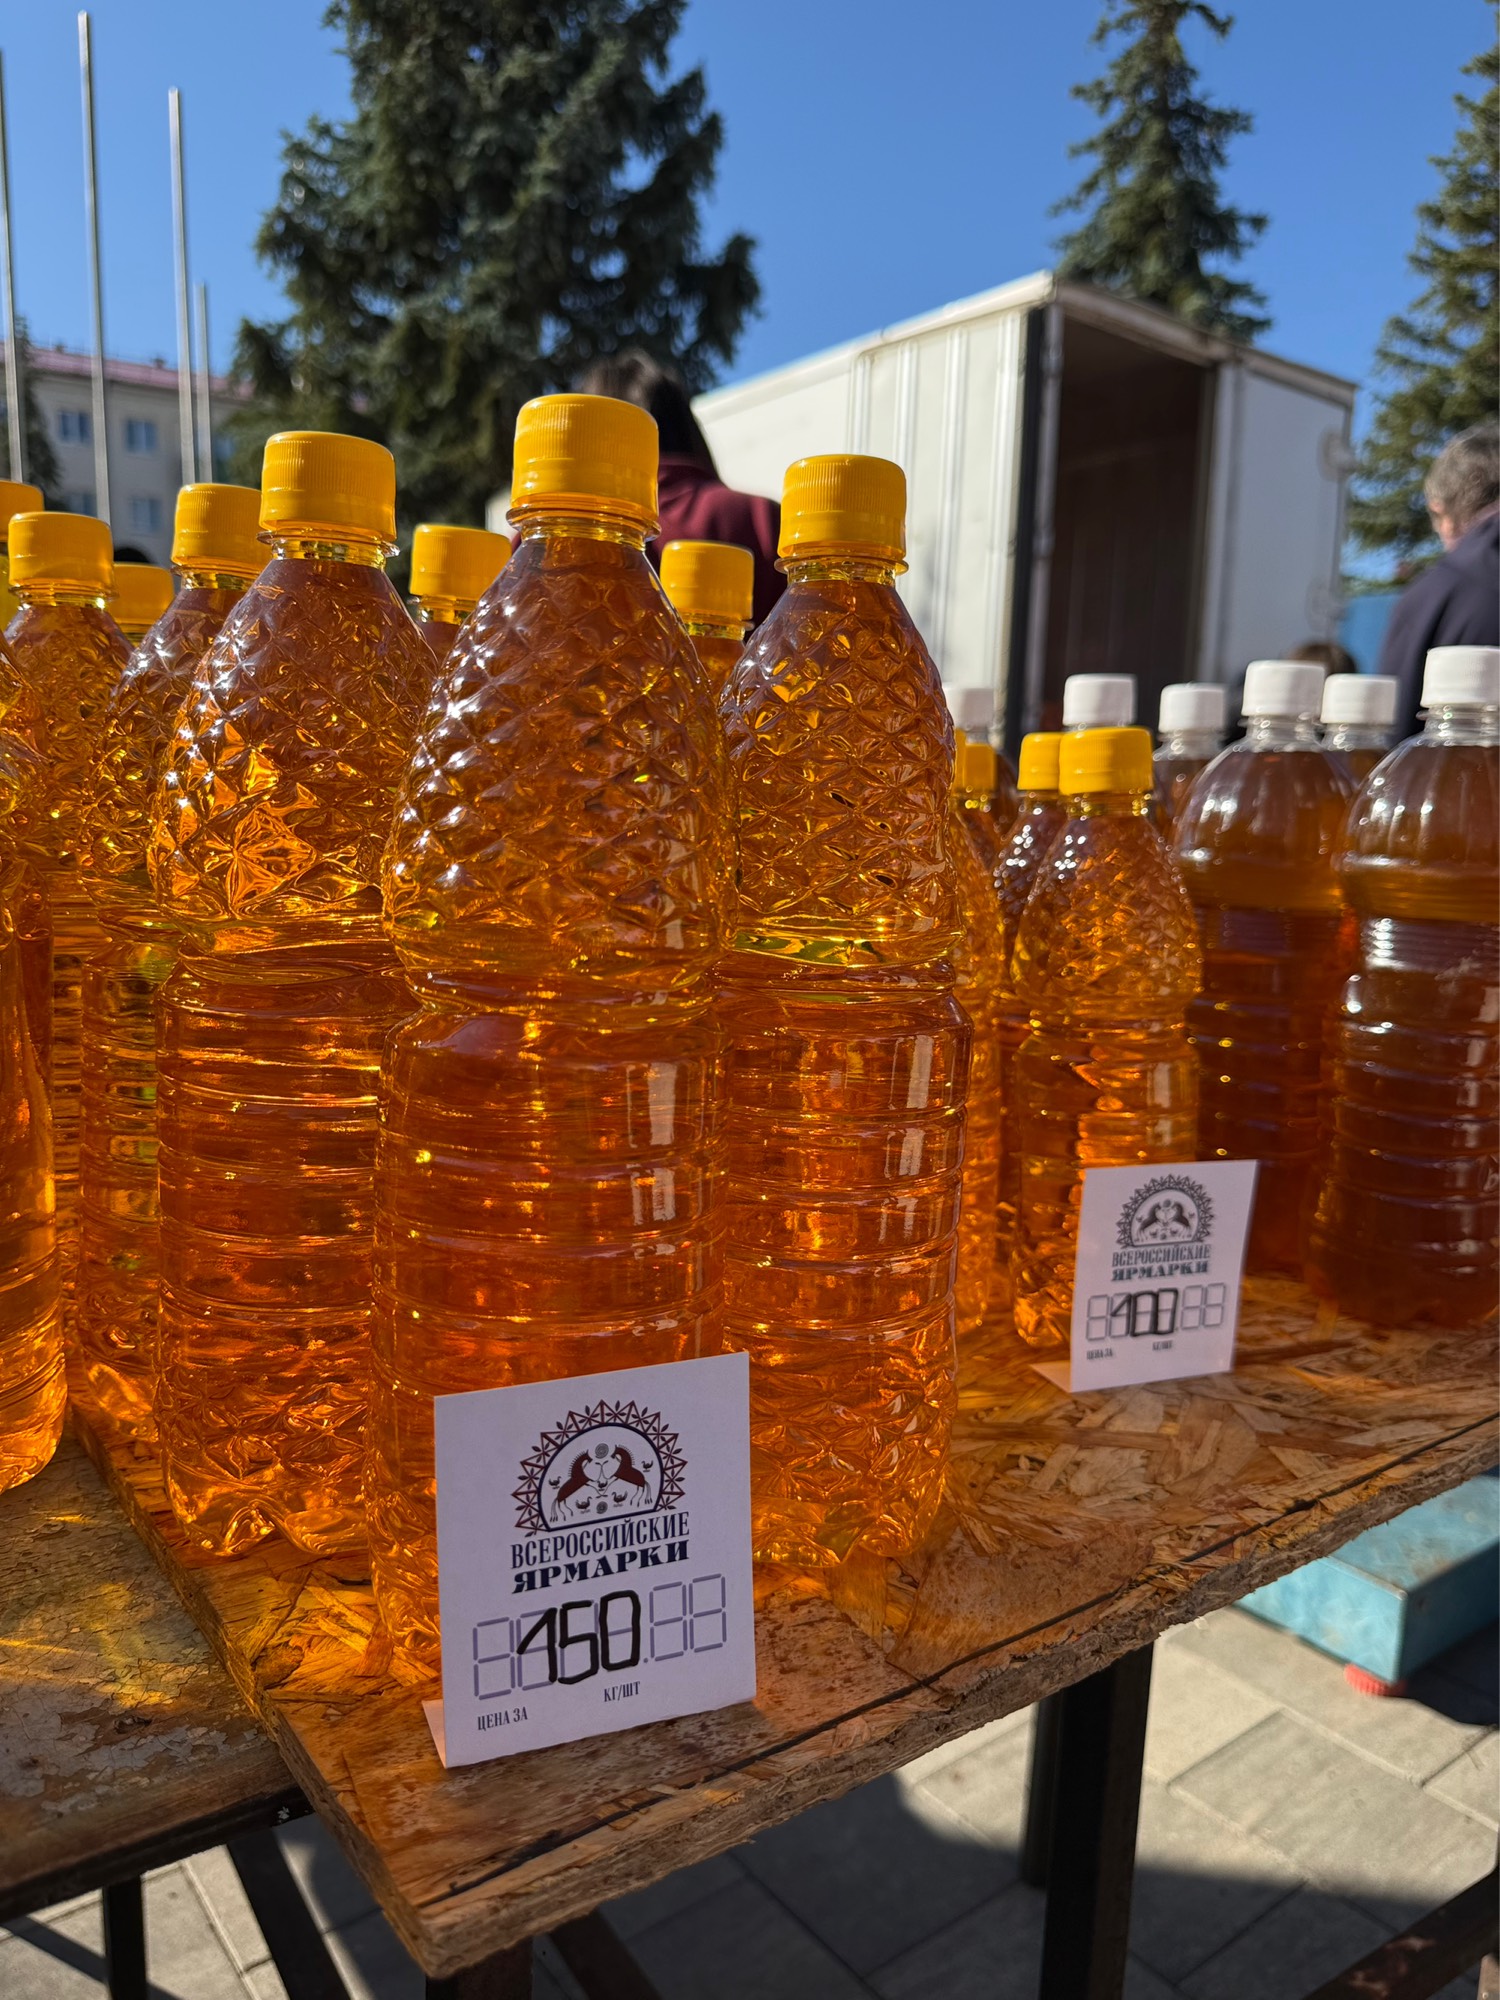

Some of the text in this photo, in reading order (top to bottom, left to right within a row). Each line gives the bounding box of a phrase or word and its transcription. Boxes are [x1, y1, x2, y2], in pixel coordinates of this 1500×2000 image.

[1111, 1261, 1209, 1282] ЯРМАРКИ
[1112, 1244, 1211, 1267] ВСЕРОССИЙСКИЕ
[511, 1511, 690, 1569] ВСЕРОССИЙСКИЕ
[512, 1540, 690, 1594] ЯРМАРКИ
[516, 1590, 641, 1684] 150
[477, 1681, 641, 1731] ЦЕНА ЗА КГ/ШТ
